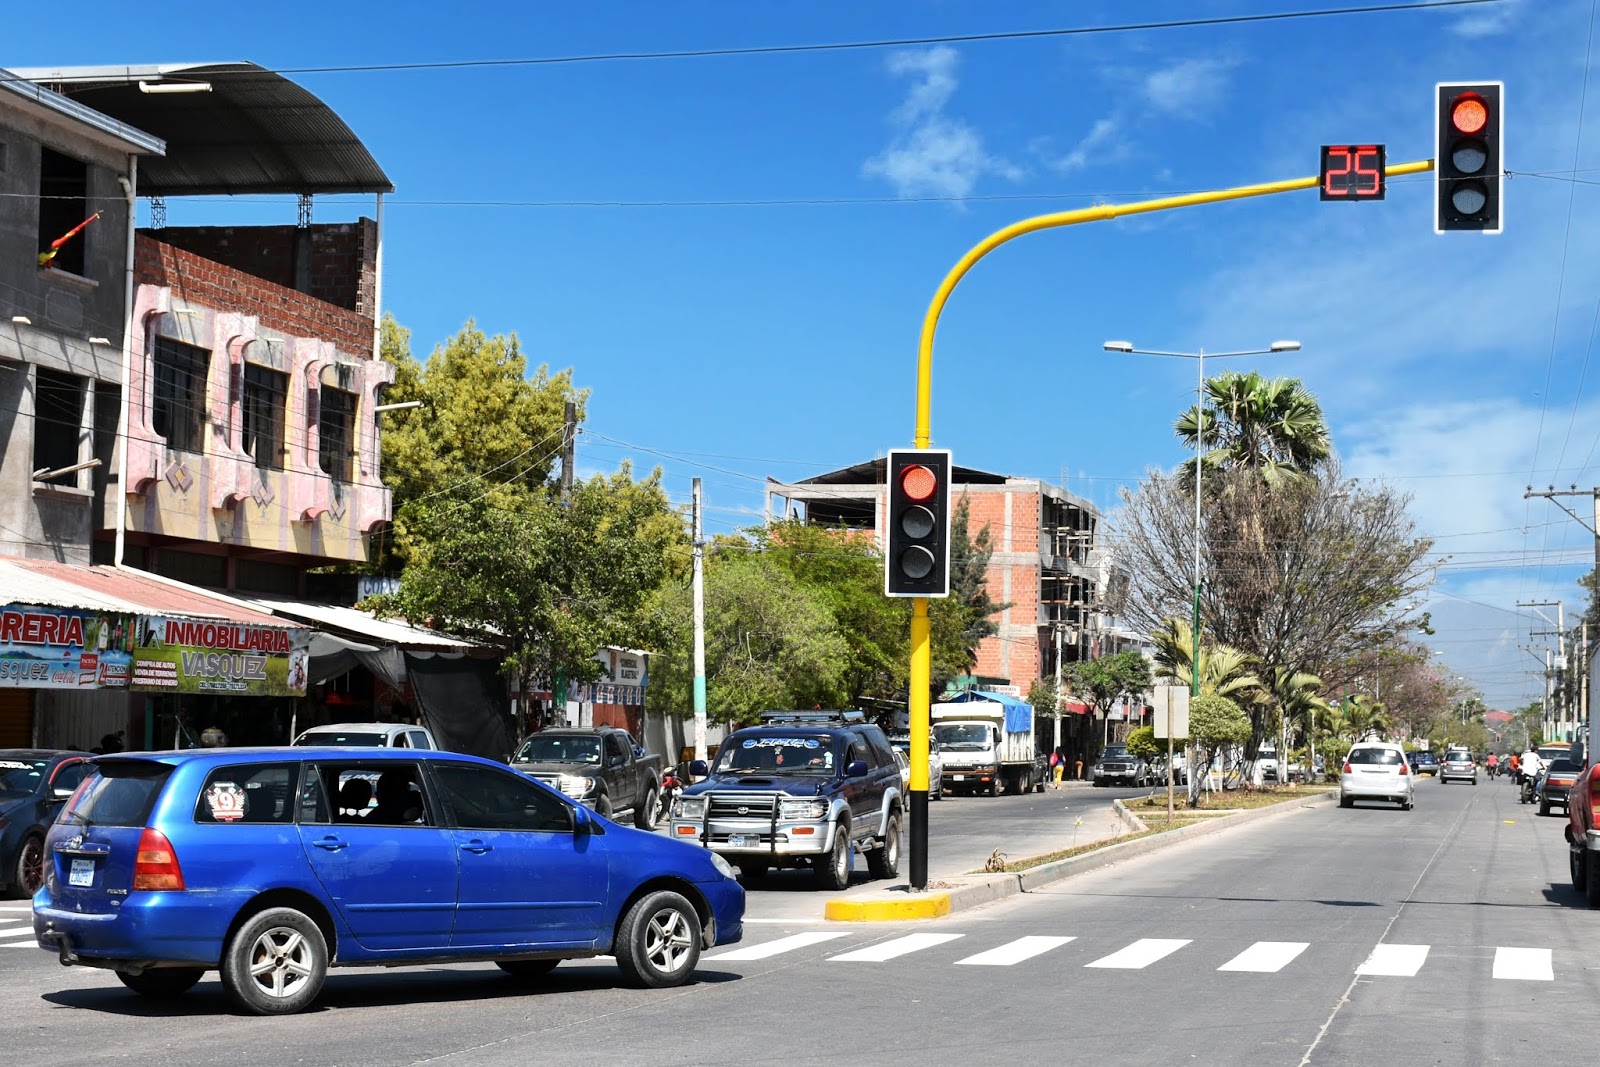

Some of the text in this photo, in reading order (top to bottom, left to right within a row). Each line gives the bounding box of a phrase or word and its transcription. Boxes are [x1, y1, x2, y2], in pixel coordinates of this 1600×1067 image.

[1325, 145, 1380, 195] 25
[0, 611, 84, 646] RERIA
[164, 620, 290, 653] INMOBILIARIA
[155, 661, 162, 669] DE
[181, 651, 267, 682] VASQUEZ
[155, 678, 162, 686] DE
